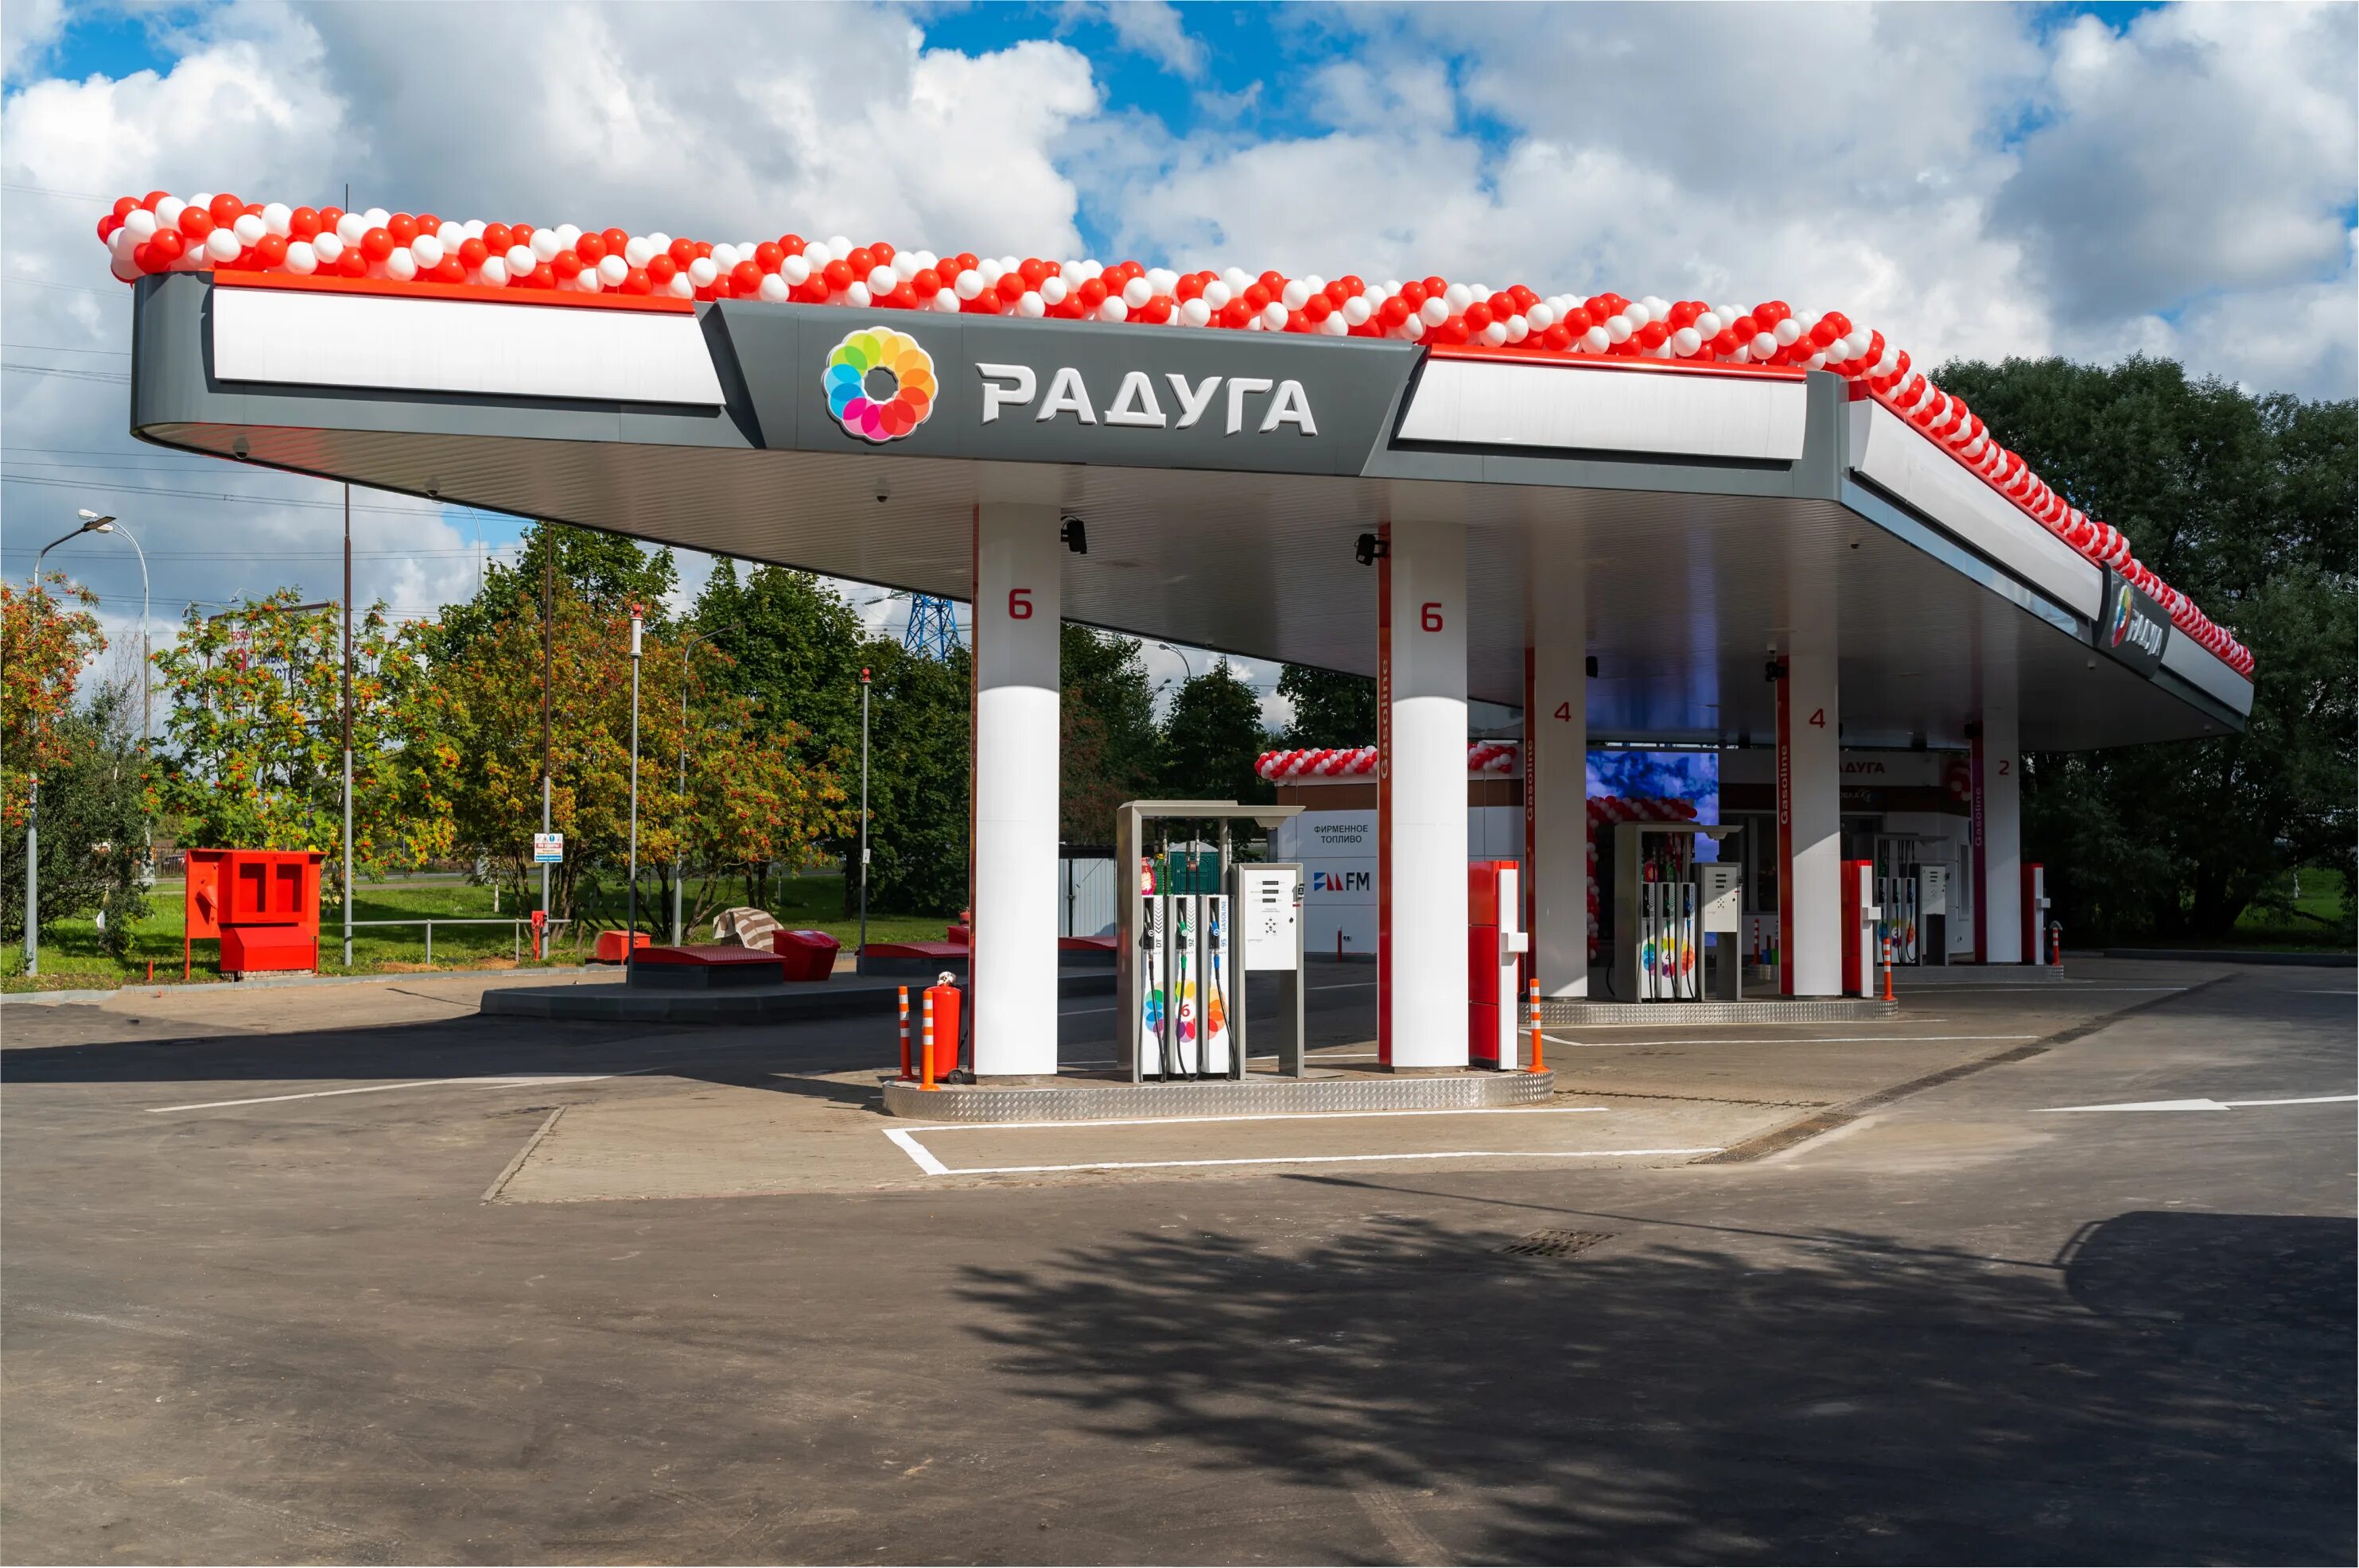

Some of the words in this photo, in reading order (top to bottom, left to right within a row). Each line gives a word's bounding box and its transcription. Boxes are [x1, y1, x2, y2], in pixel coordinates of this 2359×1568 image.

[976, 363, 1317, 437] РАДУГА
[1008, 588, 1033, 619] 6
[1420, 603, 1444, 632] 6
[1554, 701, 1572, 722] 4
[1809, 708, 1825, 728] 4
[1840, 762, 1885, 774] ДУГА
[1999, 760, 2010, 775] 2
[1314, 825, 1368, 833] ФИРМЕННОЕ
[1346, 872, 1370, 891] FM
[1188, 938, 1195, 947] 92
[1221, 938, 1227, 947] 95
[1180, 1004, 1190, 1017] 6
